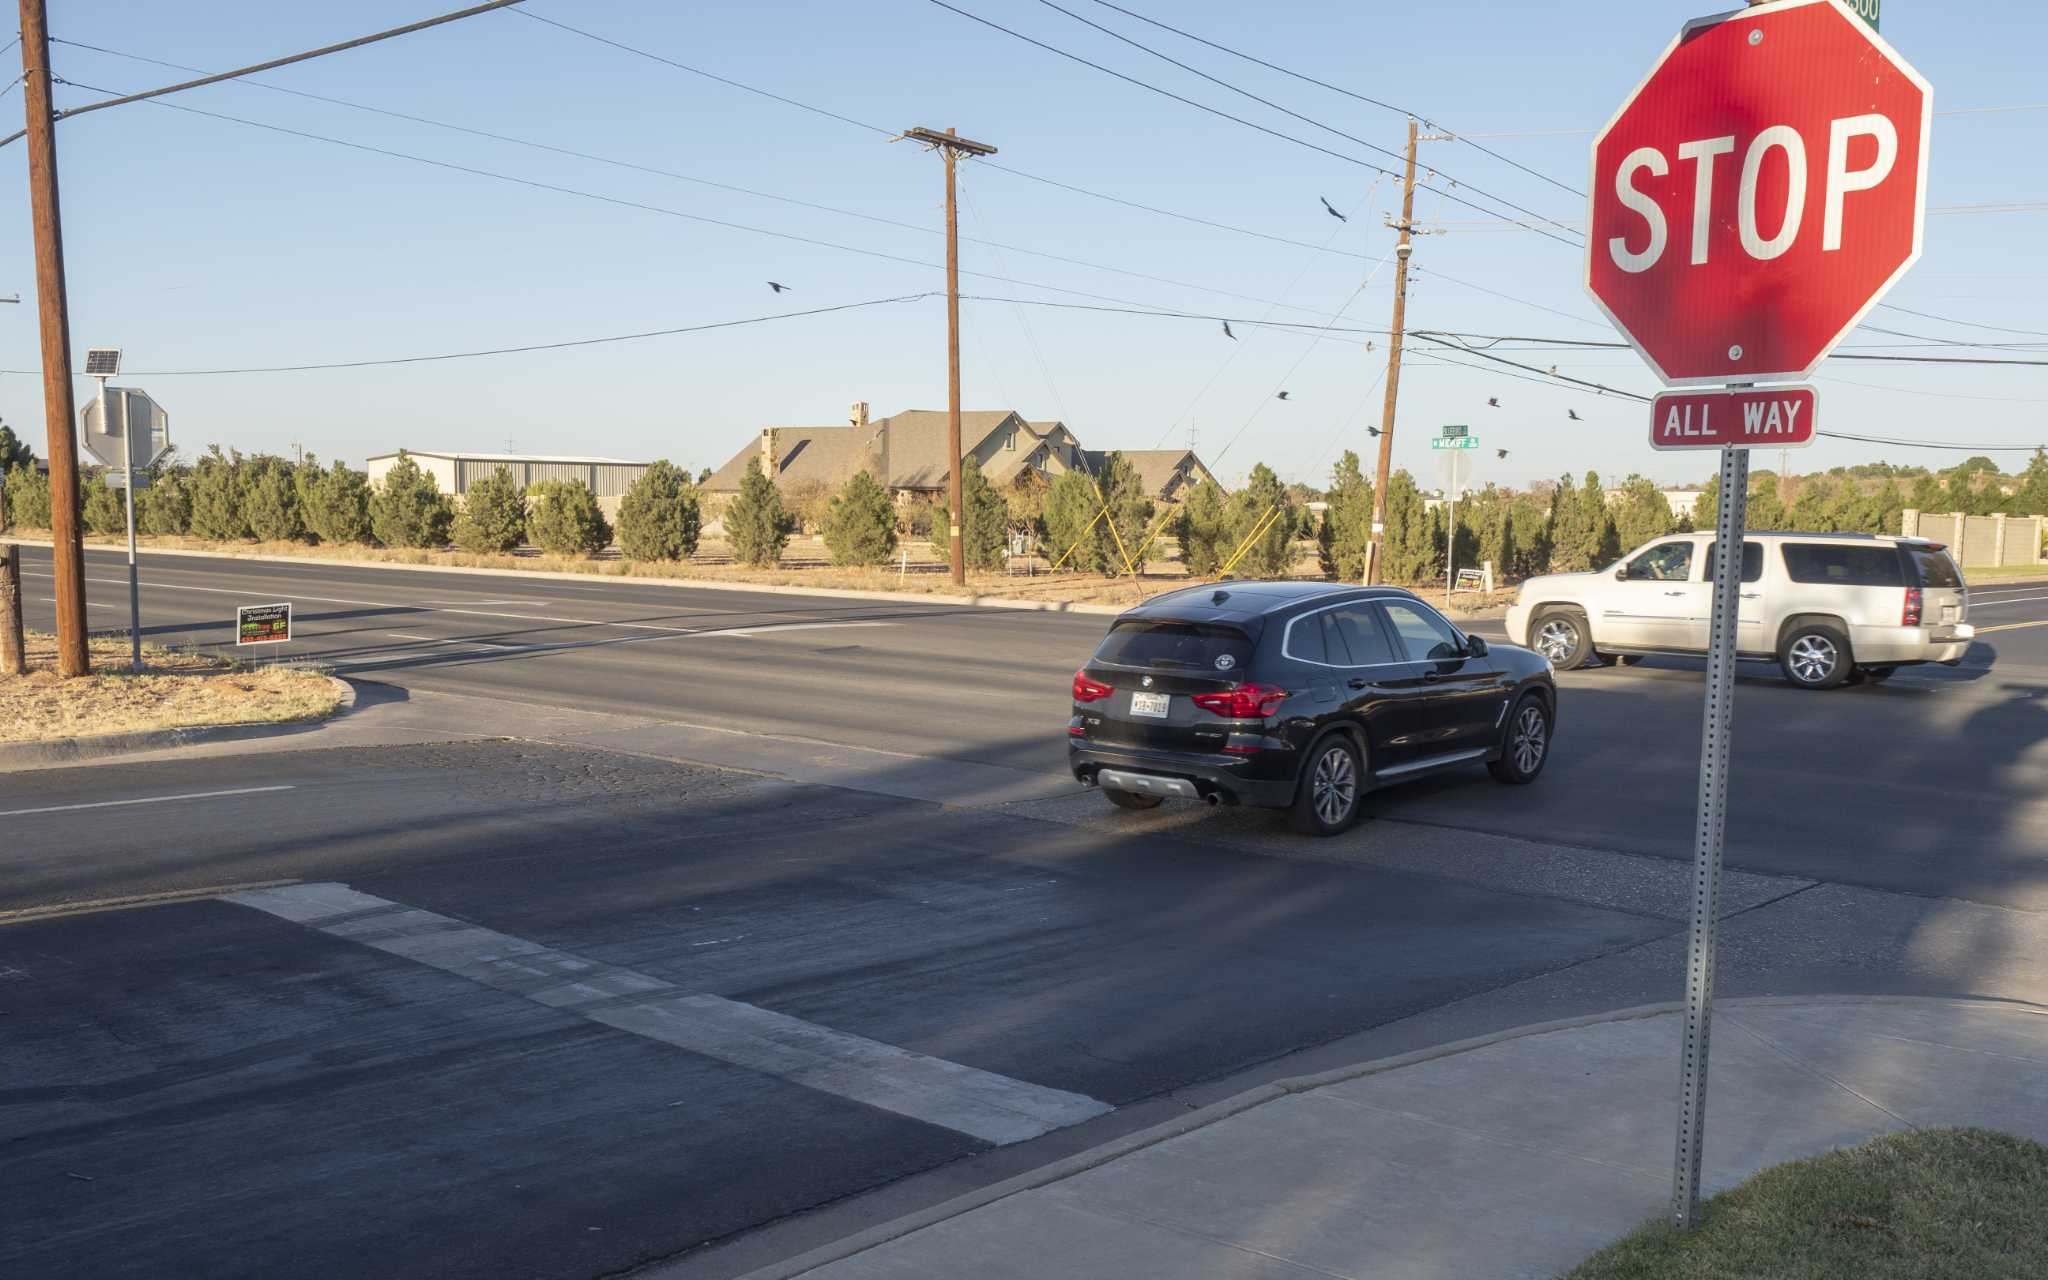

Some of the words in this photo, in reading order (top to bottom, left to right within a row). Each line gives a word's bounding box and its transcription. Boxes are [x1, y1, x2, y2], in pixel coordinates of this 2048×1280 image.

[1608, 113, 1898, 273] STOP
[1663, 404, 1717, 437] ALL
[1743, 400, 1802, 434] WAY
